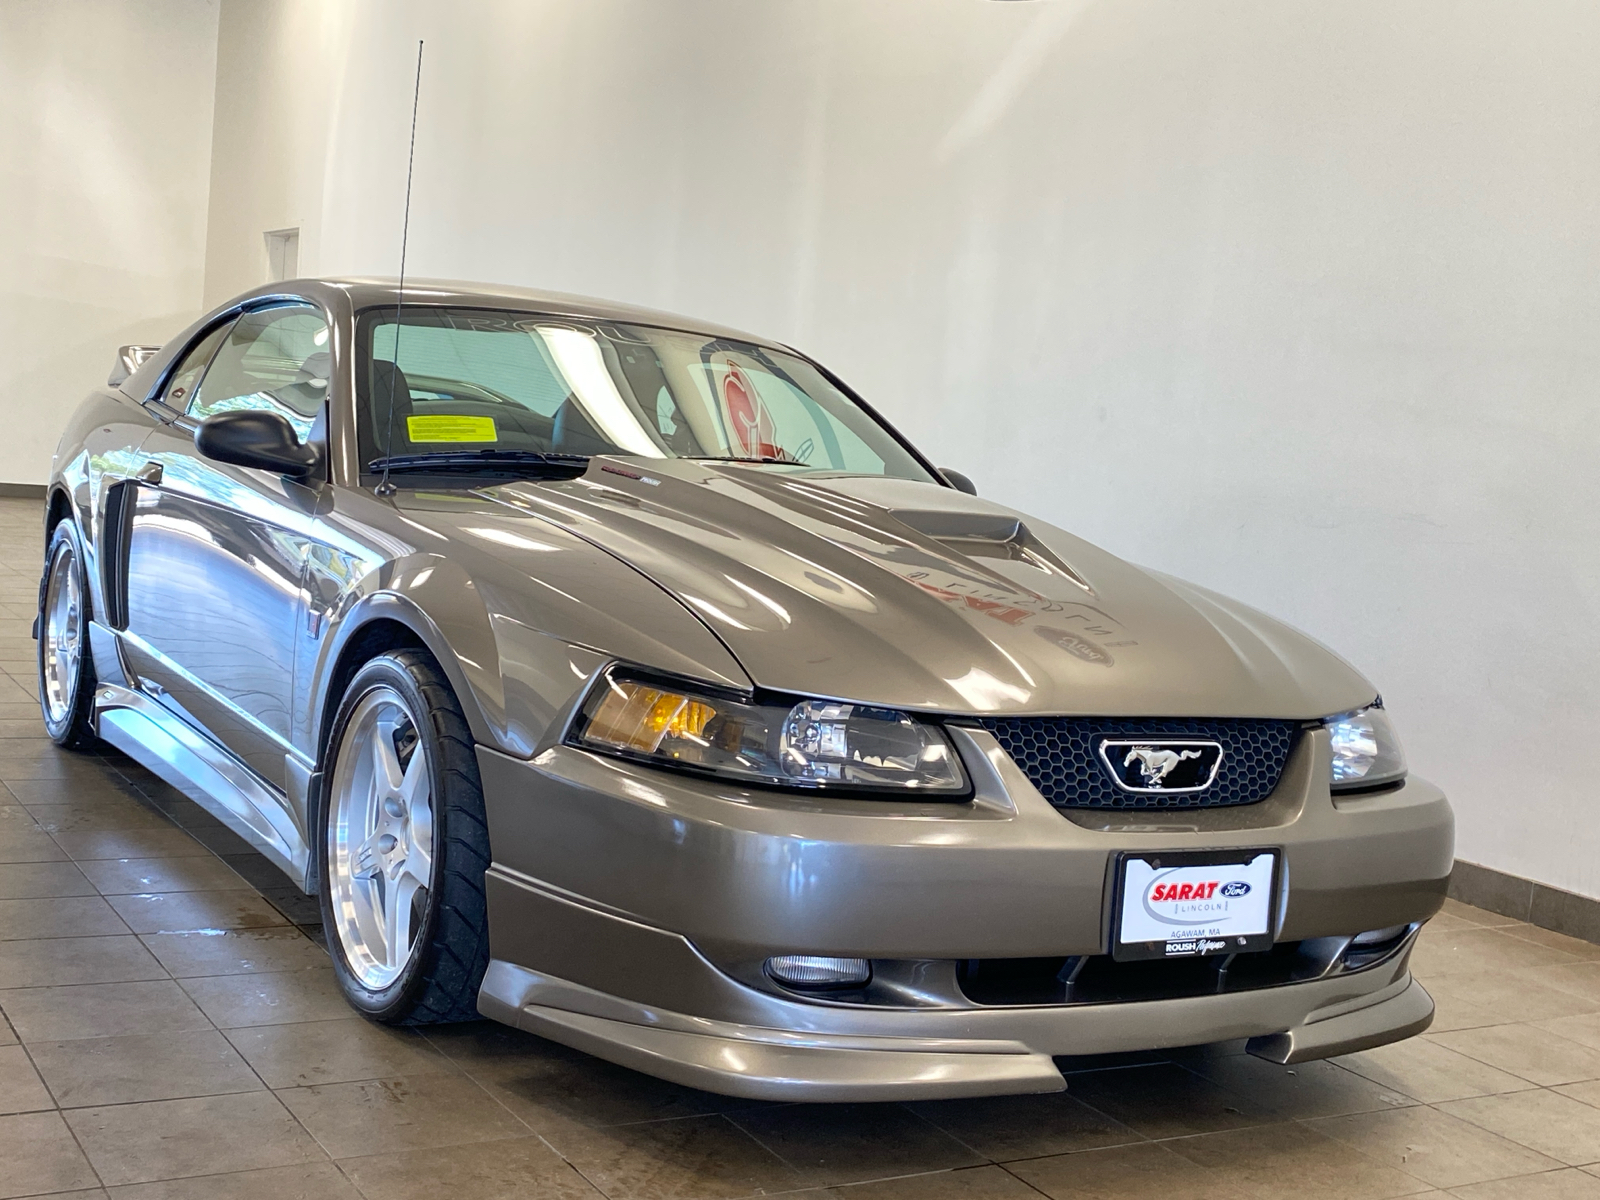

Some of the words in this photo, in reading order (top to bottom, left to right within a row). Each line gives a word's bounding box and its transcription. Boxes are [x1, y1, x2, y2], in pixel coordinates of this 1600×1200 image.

[1151, 882, 1219, 902] SARAT
[1223, 882, 1249, 896] Ford
[1181, 903, 1222, 912] LINCOLN
[1171, 929, 1207, 938] AGAWAM,
[1209, 928, 1221, 936] MA
[1166, 943, 1196, 952] ROUSH
